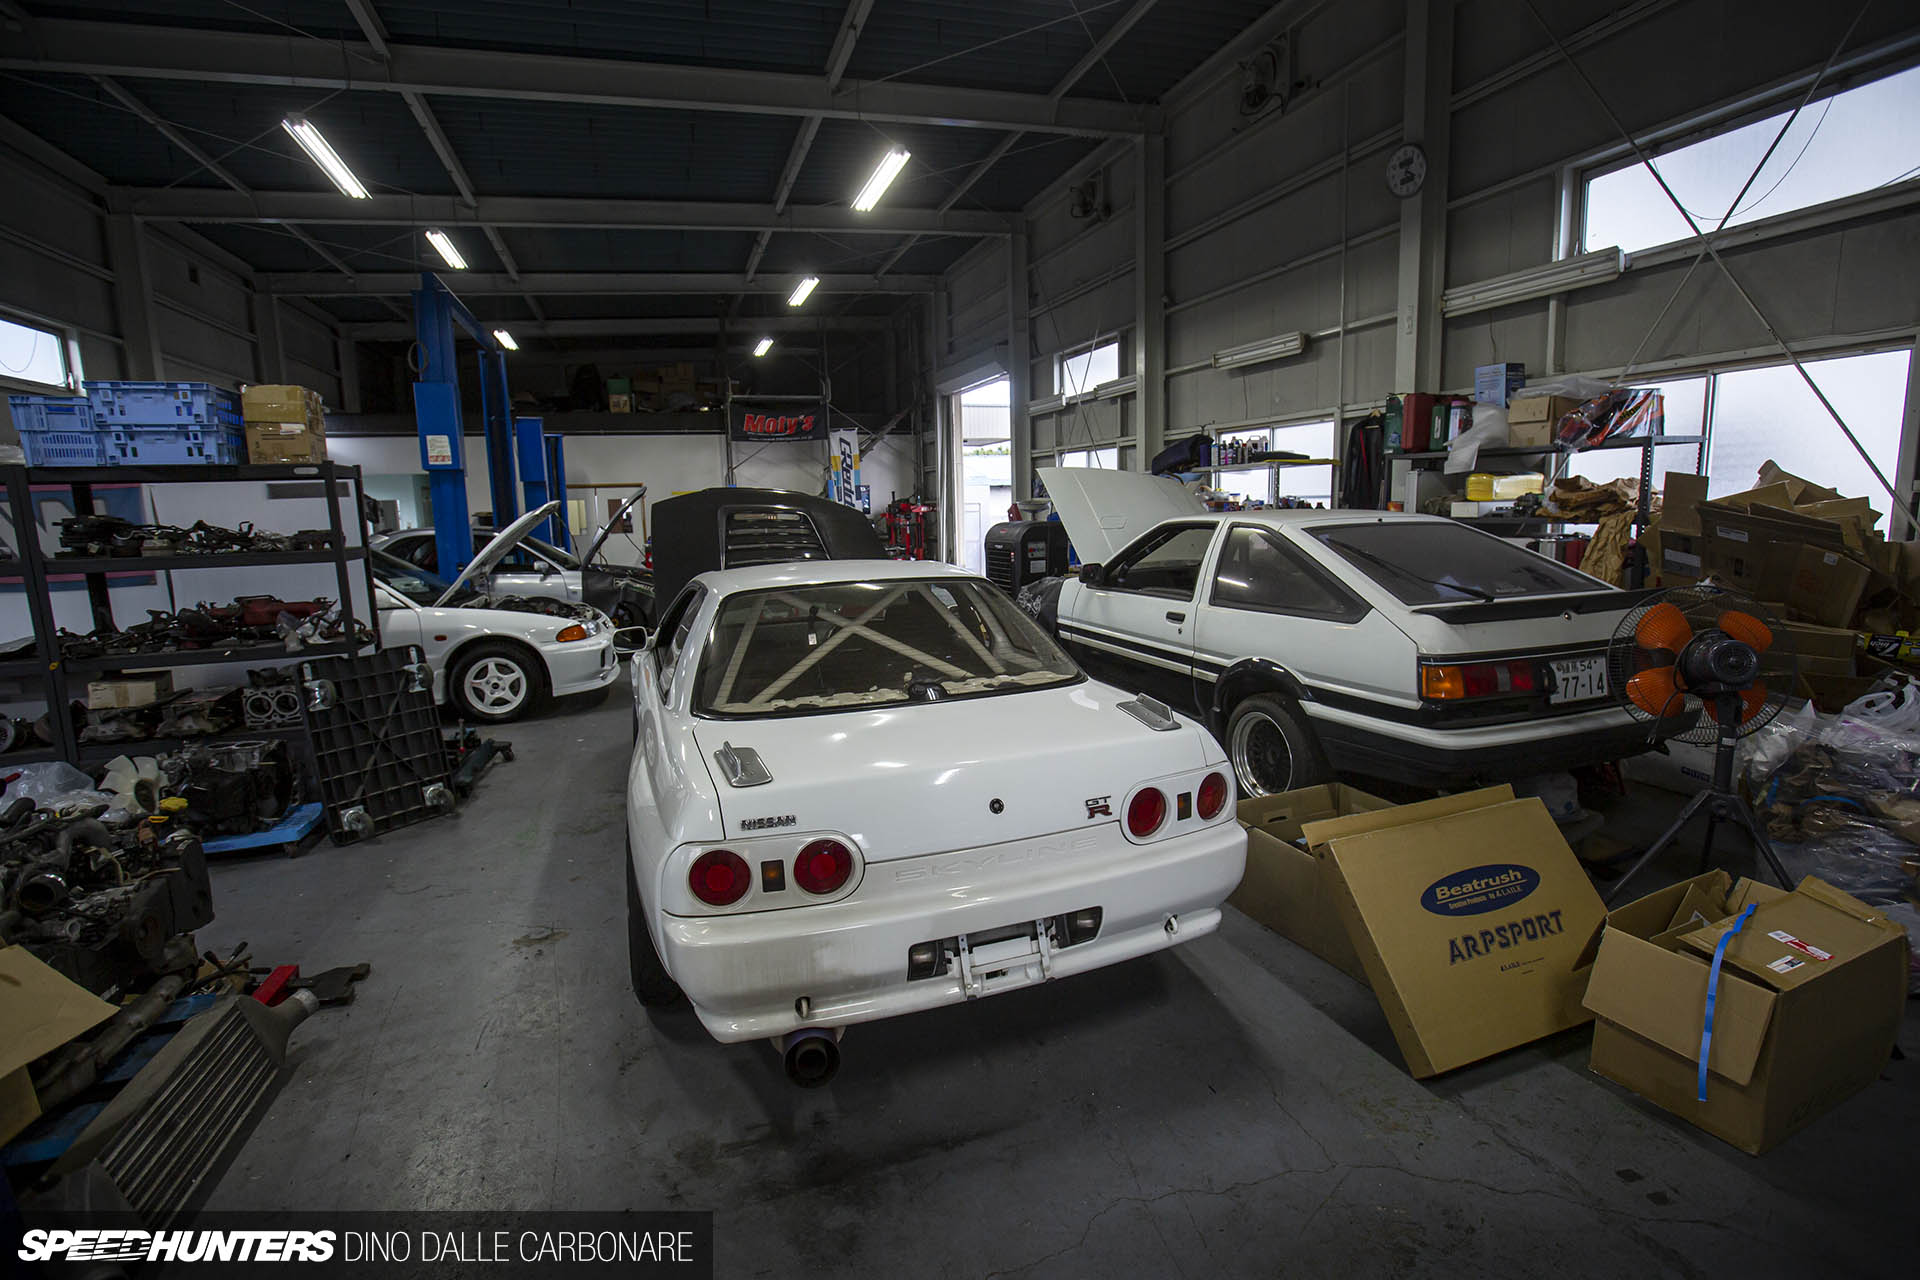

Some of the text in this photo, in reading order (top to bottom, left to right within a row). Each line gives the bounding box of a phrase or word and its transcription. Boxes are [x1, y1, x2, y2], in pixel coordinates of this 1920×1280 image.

[743, 413, 815, 435] Moty's
[1562, 671, 1605, 699] 77-14
[740, 814, 797, 831] NISSAN
[895, 834, 1098, 883] SKYLINE
[1435, 869, 1523, 900] Beatrush
[1448, 909, 1565, 966] ARPSPORT
